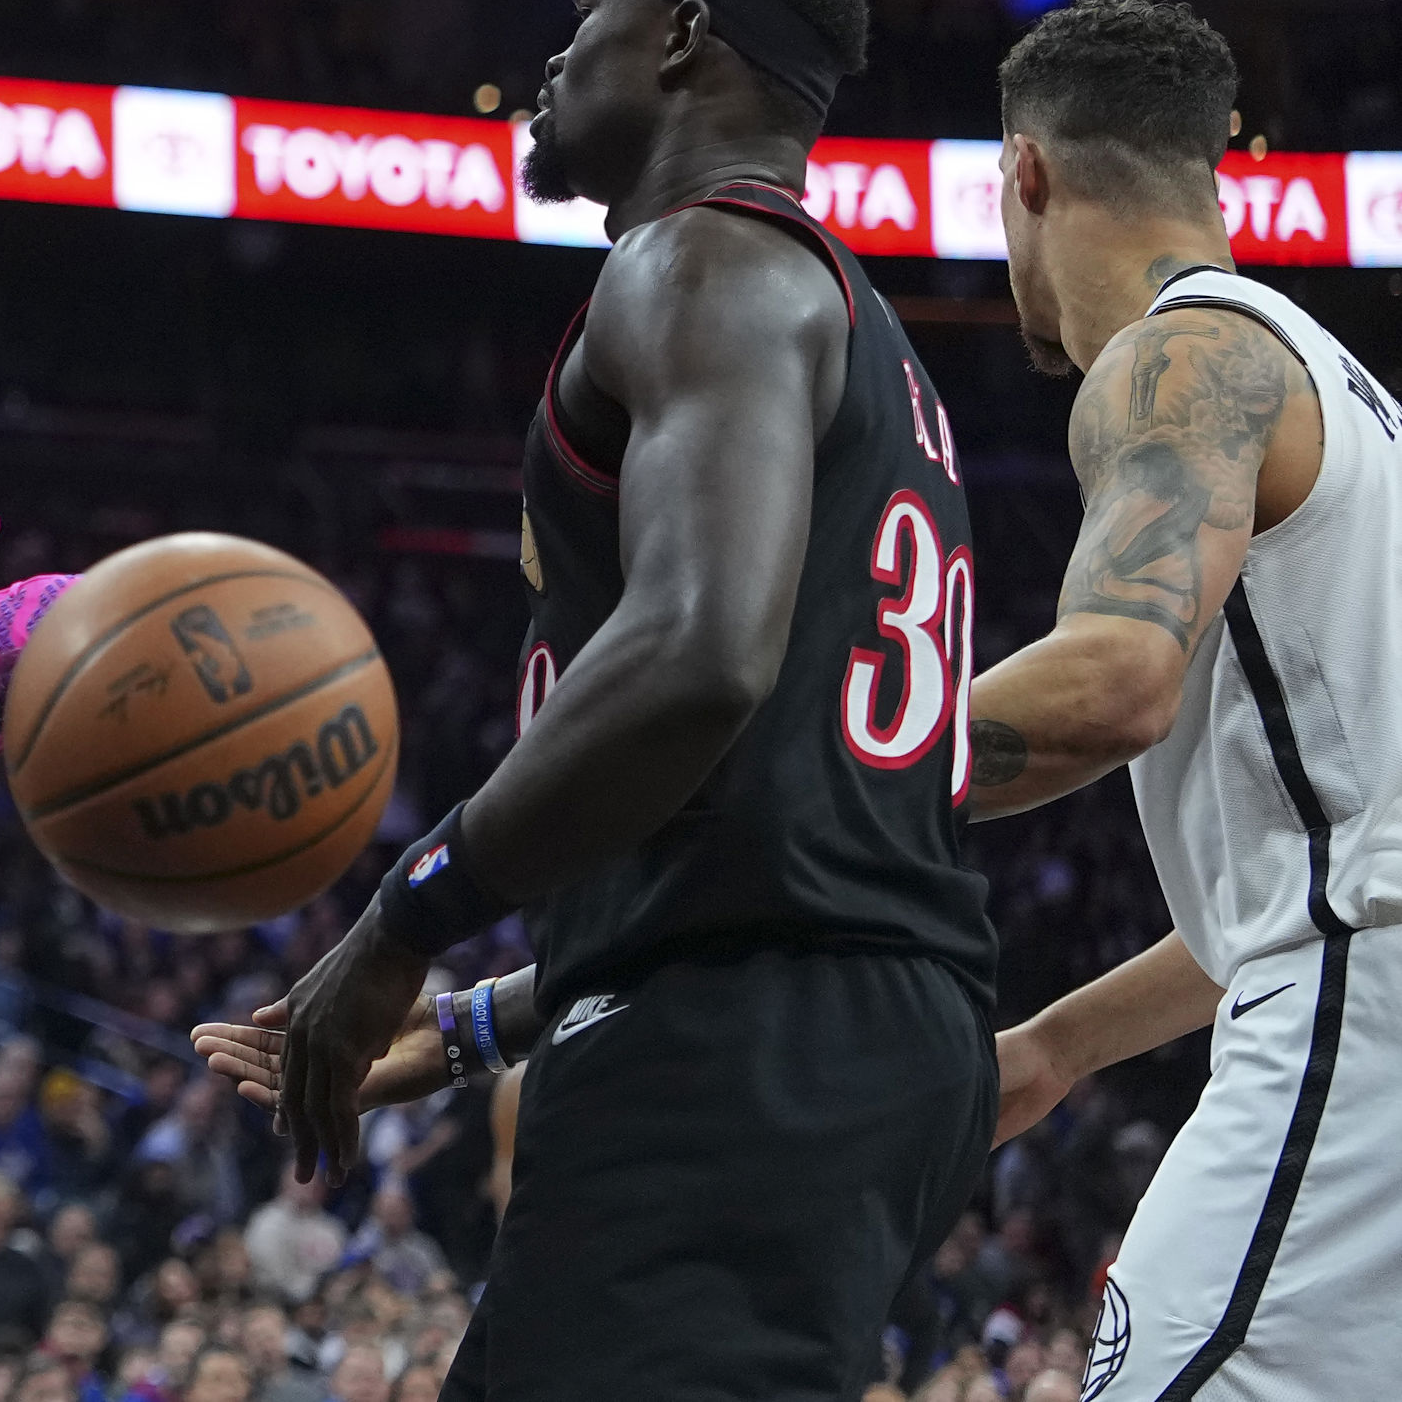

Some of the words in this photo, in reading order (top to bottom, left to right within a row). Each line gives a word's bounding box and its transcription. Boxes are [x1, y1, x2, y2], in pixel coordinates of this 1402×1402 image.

[243, 123, 505, 212] TOYOTA
[132, 703, 378, 840] Wilson
[562, 994, 615, 1026] NIKE
